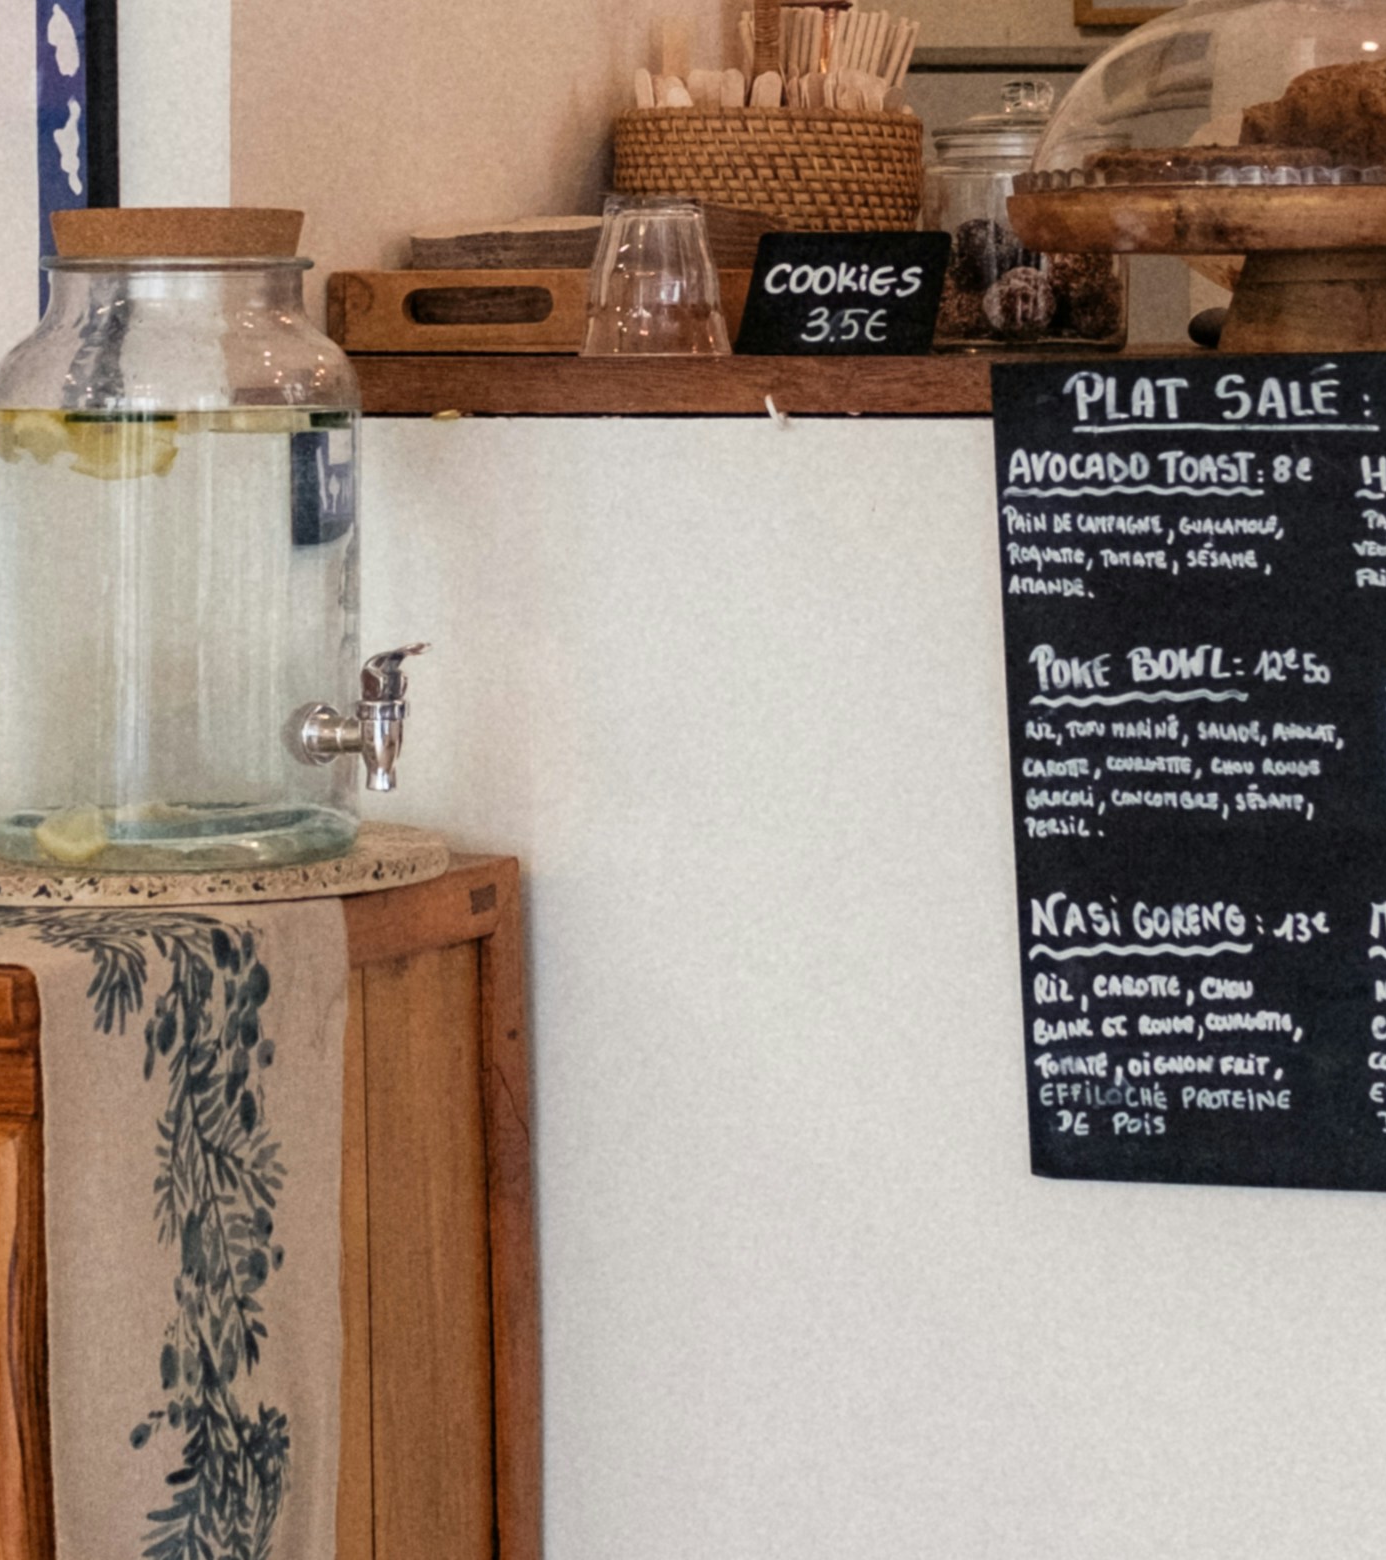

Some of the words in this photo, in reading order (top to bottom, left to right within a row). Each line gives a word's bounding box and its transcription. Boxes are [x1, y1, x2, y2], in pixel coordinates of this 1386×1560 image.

[800, 307, 888, 344] 3.5€
[1063, 372, 1190, 421] PLAT
[1009, 449, 1150, 483] AVOCADO
[1029, 643, 1112, 692] POKE
[1200, 976, 1254, 999] CHOU
[1056, 1110, 1089, 1136] DE
